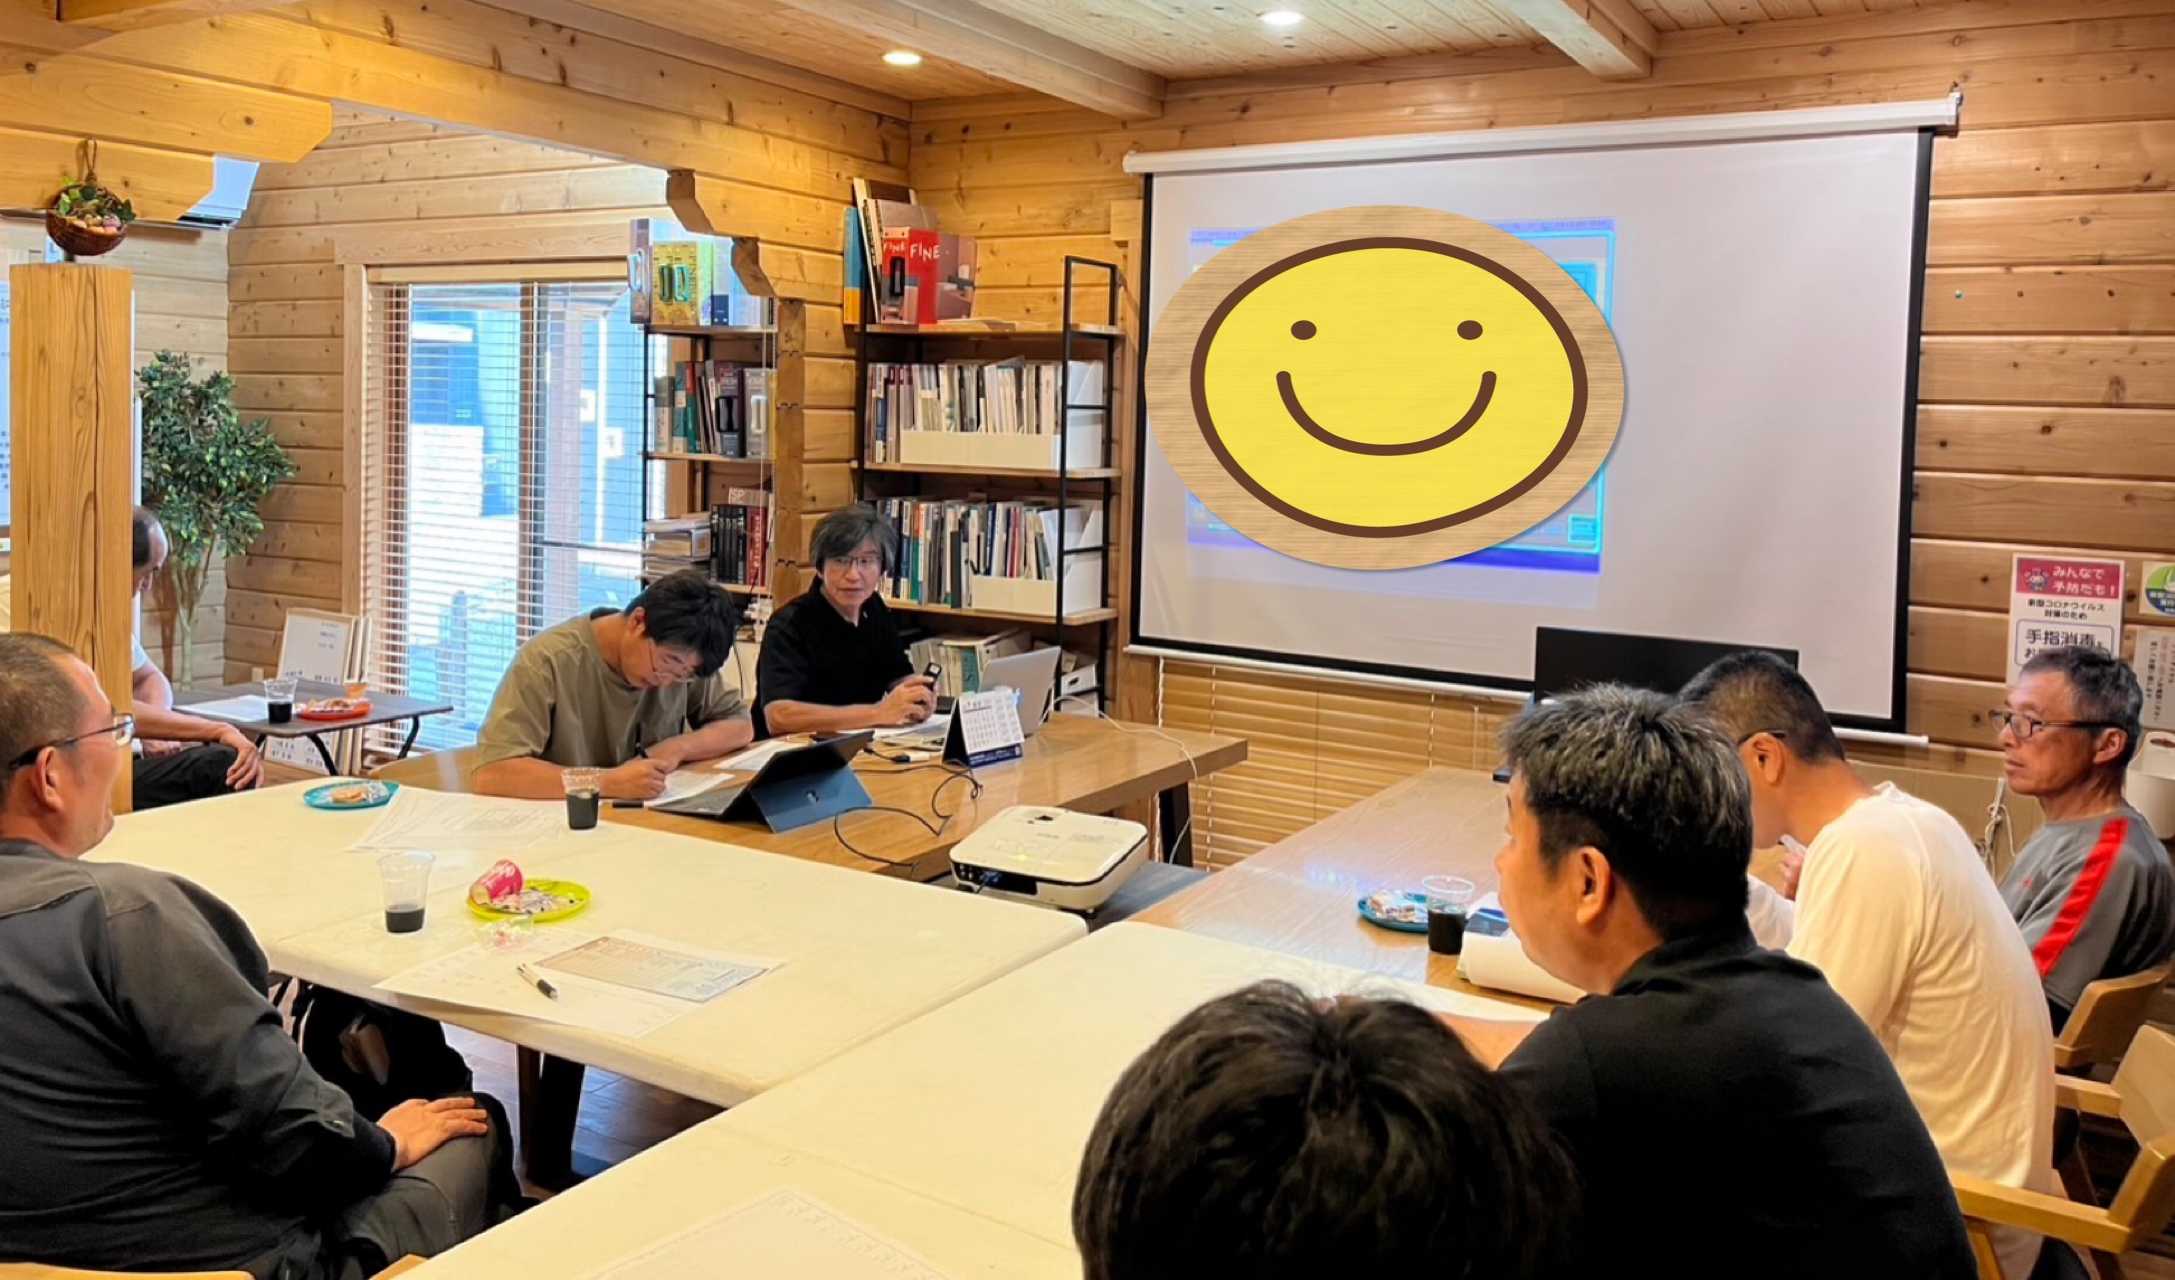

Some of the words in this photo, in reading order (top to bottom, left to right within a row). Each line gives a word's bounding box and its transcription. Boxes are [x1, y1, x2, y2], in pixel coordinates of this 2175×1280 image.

[909, 239, 941, 262] FINE
[2052, 565, 2105, 580] みんなで
